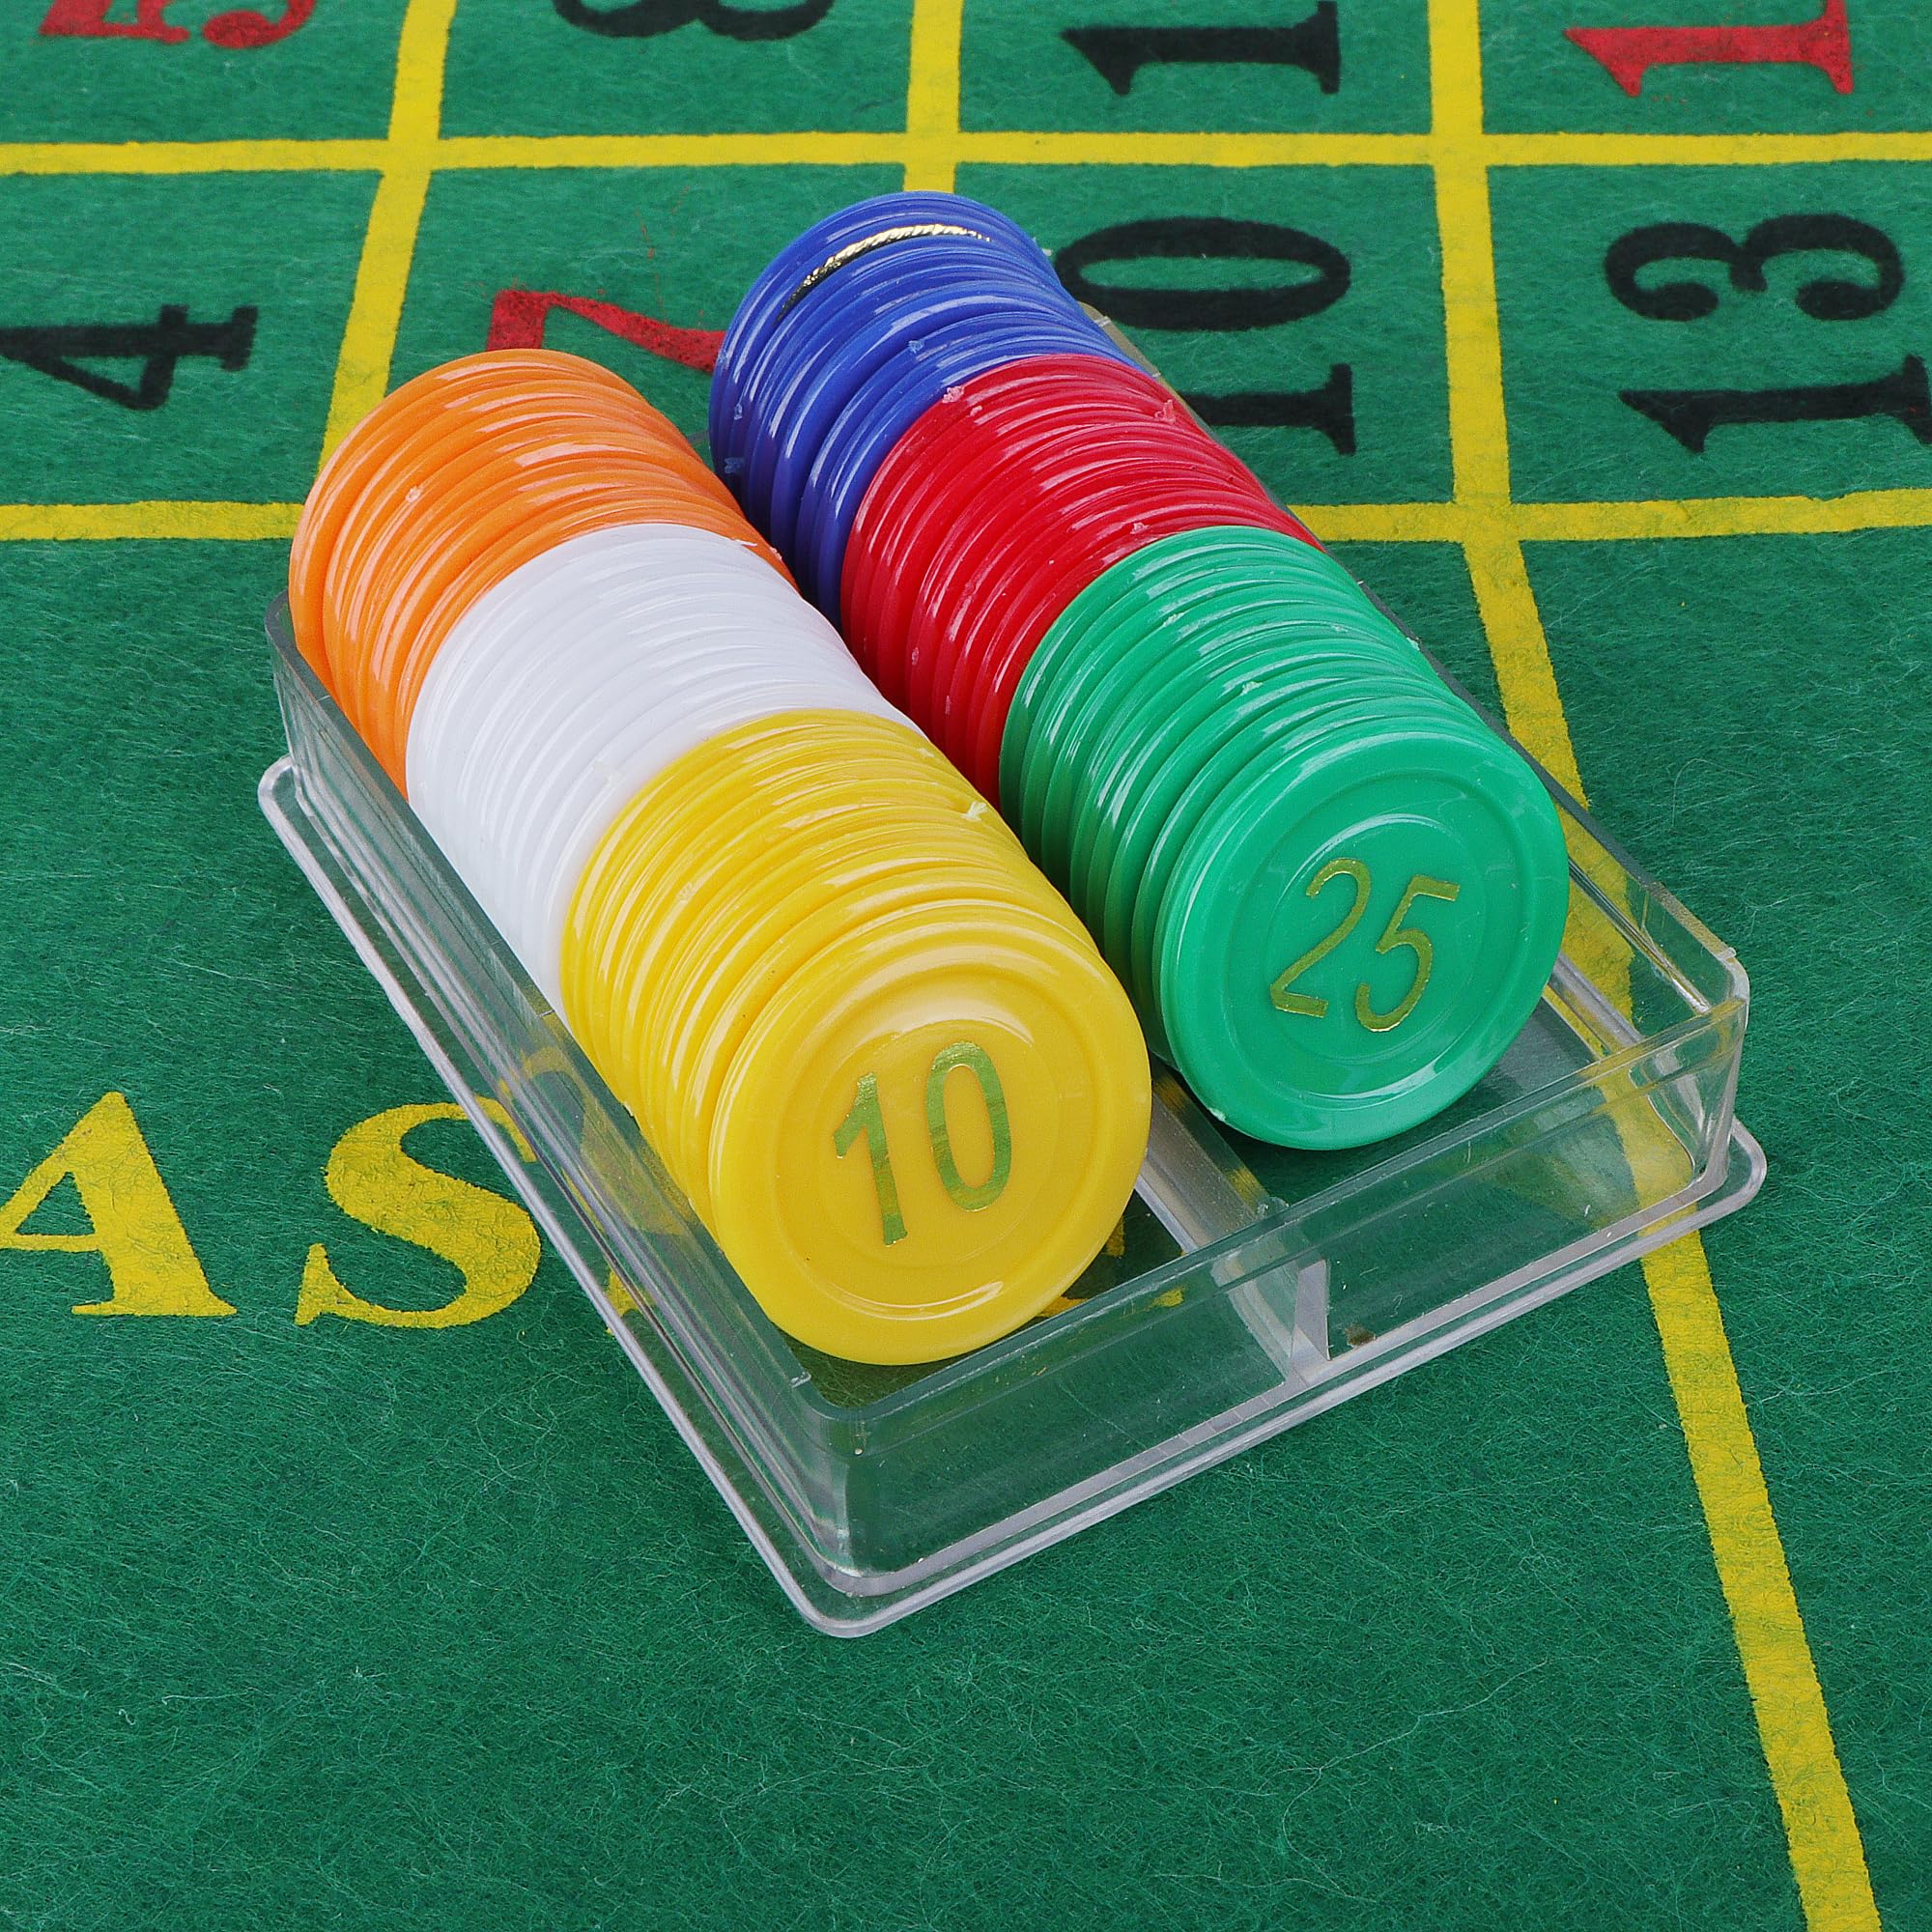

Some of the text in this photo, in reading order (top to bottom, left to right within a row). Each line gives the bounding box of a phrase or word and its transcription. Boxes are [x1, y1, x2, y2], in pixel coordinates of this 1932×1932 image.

[0, 304, 259, 411] 4
[1604, 213, 1932, 454] 13
[1268, 857, 1460, 1035] 25
[0, 1091, 667, 1335] AS
[833, 1039, 1013, 1247] 10
